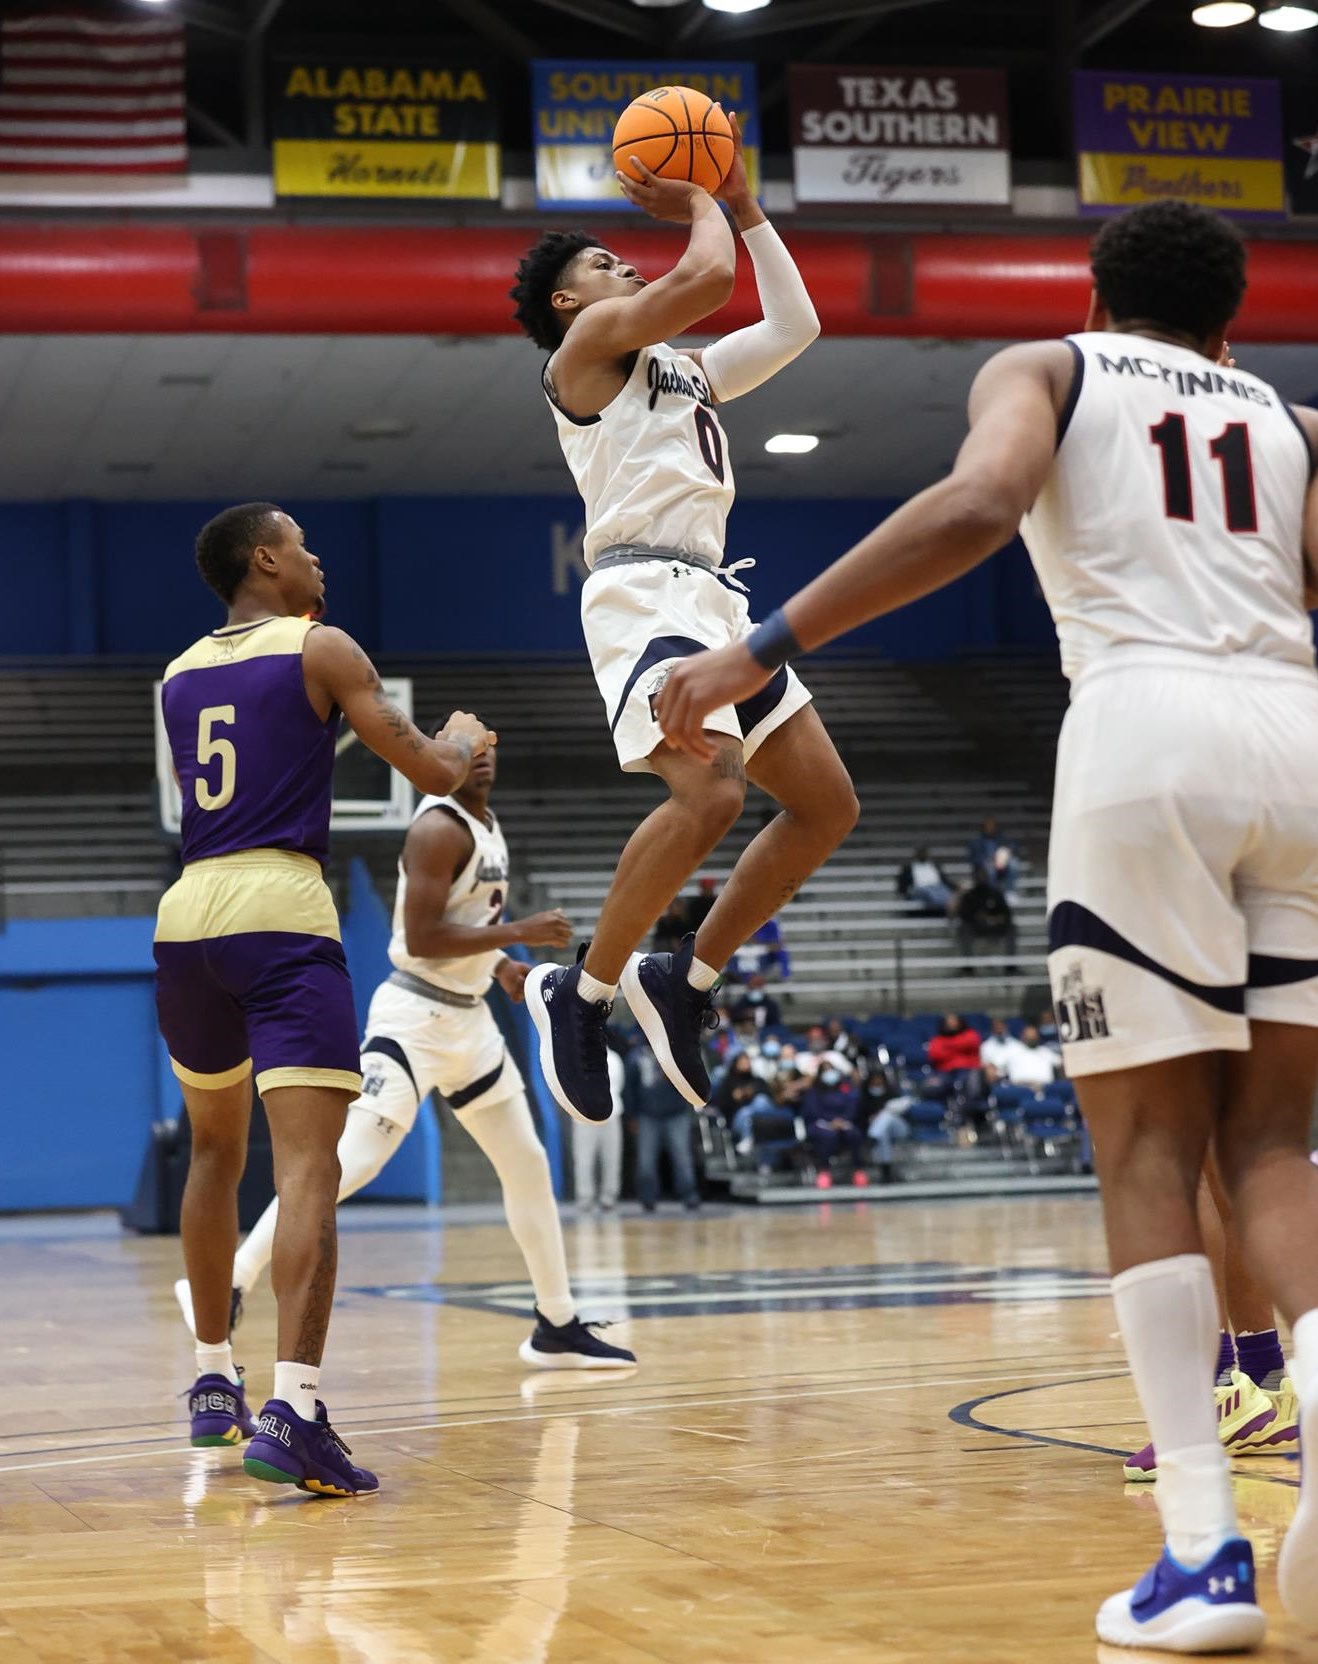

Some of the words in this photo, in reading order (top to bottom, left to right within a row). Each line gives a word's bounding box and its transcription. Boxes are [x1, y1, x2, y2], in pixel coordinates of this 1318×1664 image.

[285, 66, 486, 102] ALABAMA
[838, 77, 958, 109] TEXAS
[1103, 84, 1252, 117] PRAIRIE
[334, 103, 440, 136] STATE
[802, 111, 998, 144] SOUTHERN
[1127, 120, 1231, 150] VIEW
[842, 152, 961, 197] Tigers
[1119, 164, 1243, 199] Panthers
[694, 404, 725, 487] 0
[1149, 411, 1258, 533] 11
[195, 704, 237, 811] 5
